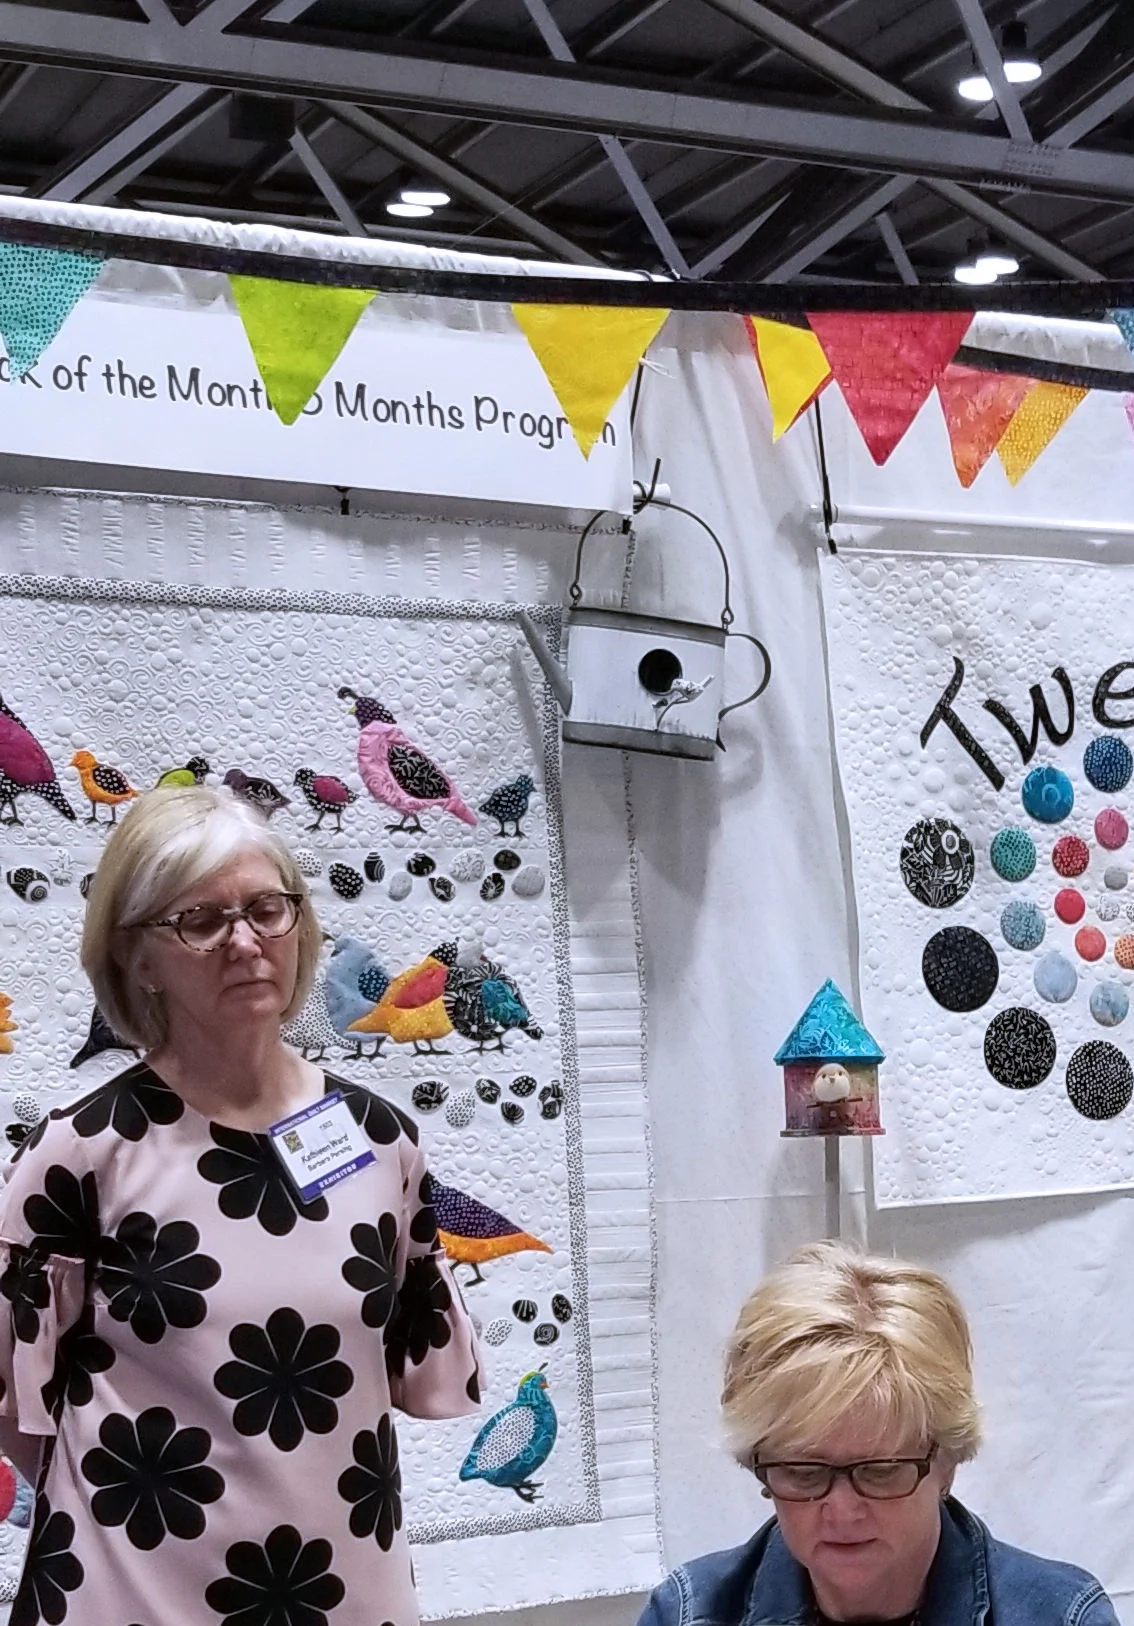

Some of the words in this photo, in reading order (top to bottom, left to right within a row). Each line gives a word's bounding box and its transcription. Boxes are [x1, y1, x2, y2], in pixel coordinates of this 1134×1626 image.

[52, 354, 92, 392] of
[102, 359, 157, 399] the
[166, 364, 273, 411] Mont
[334, 381, 465, 430] Months
[473, 395, 616, 450] Progrm
